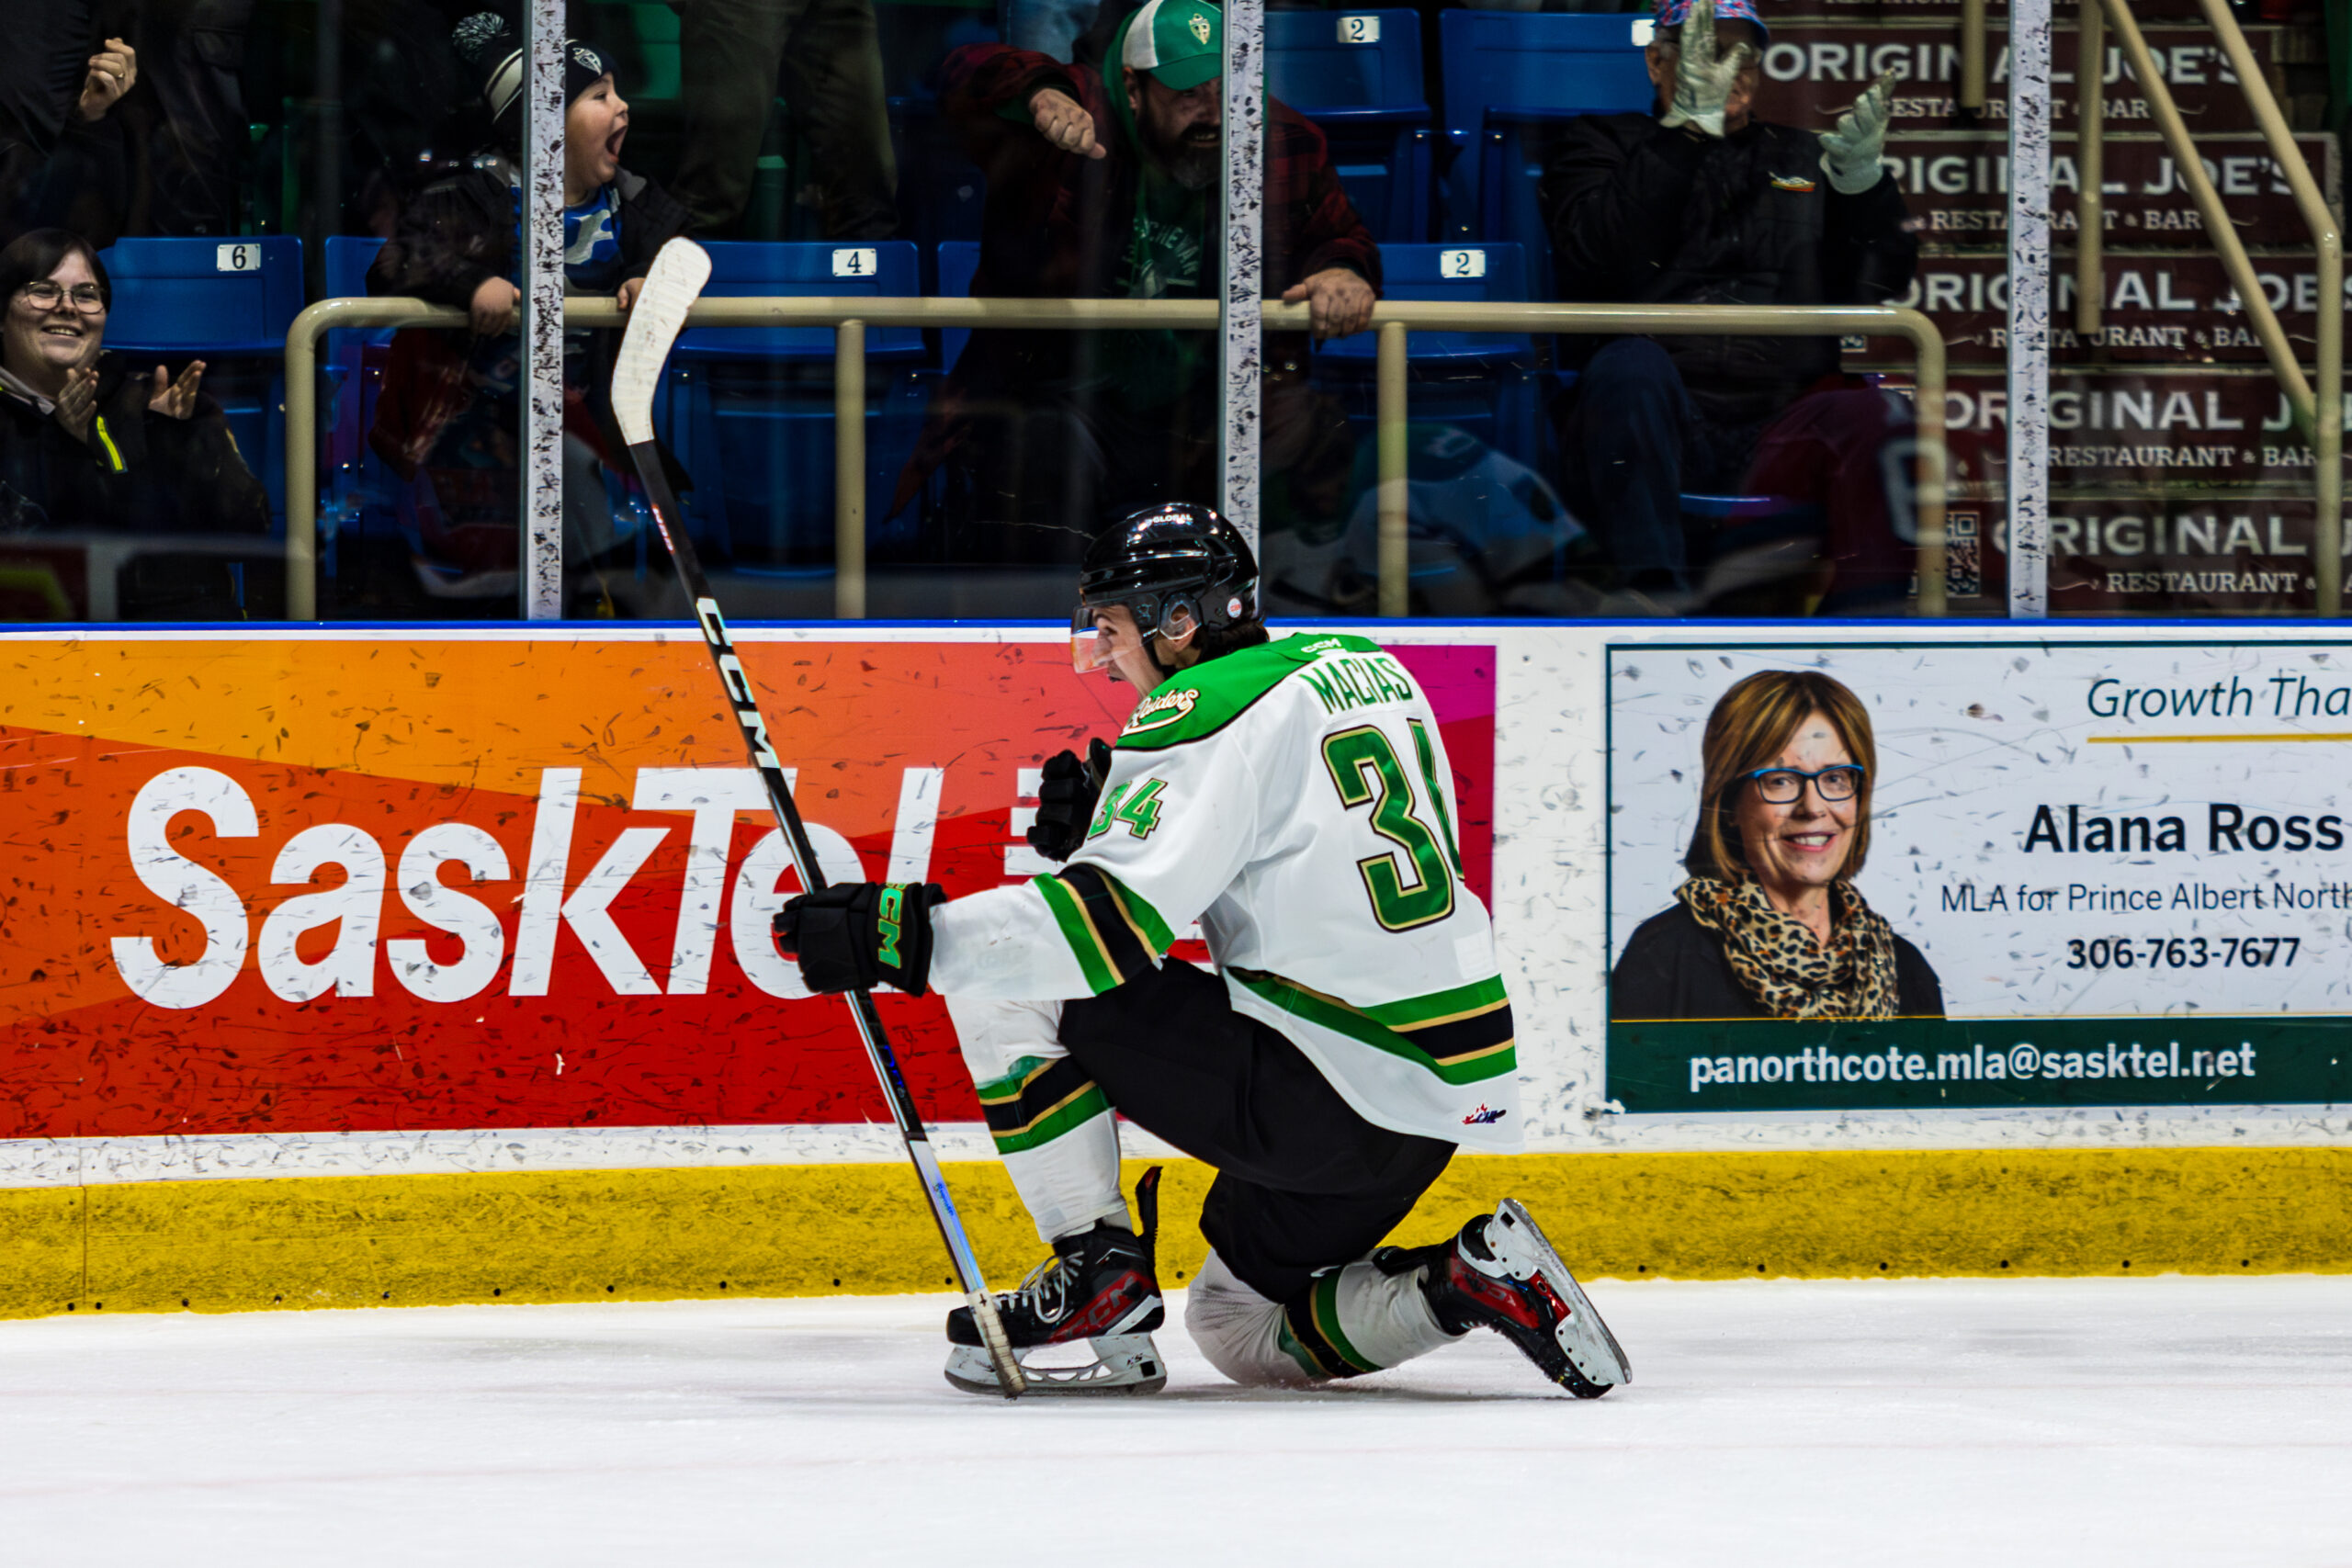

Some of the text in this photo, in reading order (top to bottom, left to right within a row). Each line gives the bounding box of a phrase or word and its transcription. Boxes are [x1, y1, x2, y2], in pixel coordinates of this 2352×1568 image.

[1351, 18, 1365, 41] 2
[1762, 42, 2075, 83] ORIGIN
[2143, 209, 2202, 230] BAR
[232, 245, 247, 270] 6
[846, 251, 863, 274] 4
[1455, 252, 1471, 276] 2
[1990, 326, 2188, 348] RTAURANT
[2213, 326, 2263, 347] BA
[1945, 390, 2245, 431] ORGINAL
[2048, 445, 2236, 468] RESTAURANT
[2106, 571, 2300, 594] RESTAURANT
[1300, 637, 1342, 653] CCM
[695, 597, 782, 770] CCM
[1297, 657, 1414, 716] MACIAS
[2087, 675, 2352, 719] Growth Tha
[1087, 777, 1169, 840] 34
[2023, 803, 2345, 853] Alana Ross
[110, 766, 943, 1010] SaskTel
[1941, 884, 2009, 912] MLA
[2016, 884, 2060, 911] for
[2068, 883, 2163, 911] Prince
[2170, 882, 2265, 910] Albert
[878, 882, 904, 970] CM
[2066, 937, 2301, 970] 306-763-7677
[1690, 1042, 2256, 1093] panorthcote.mla@sasktel.net
